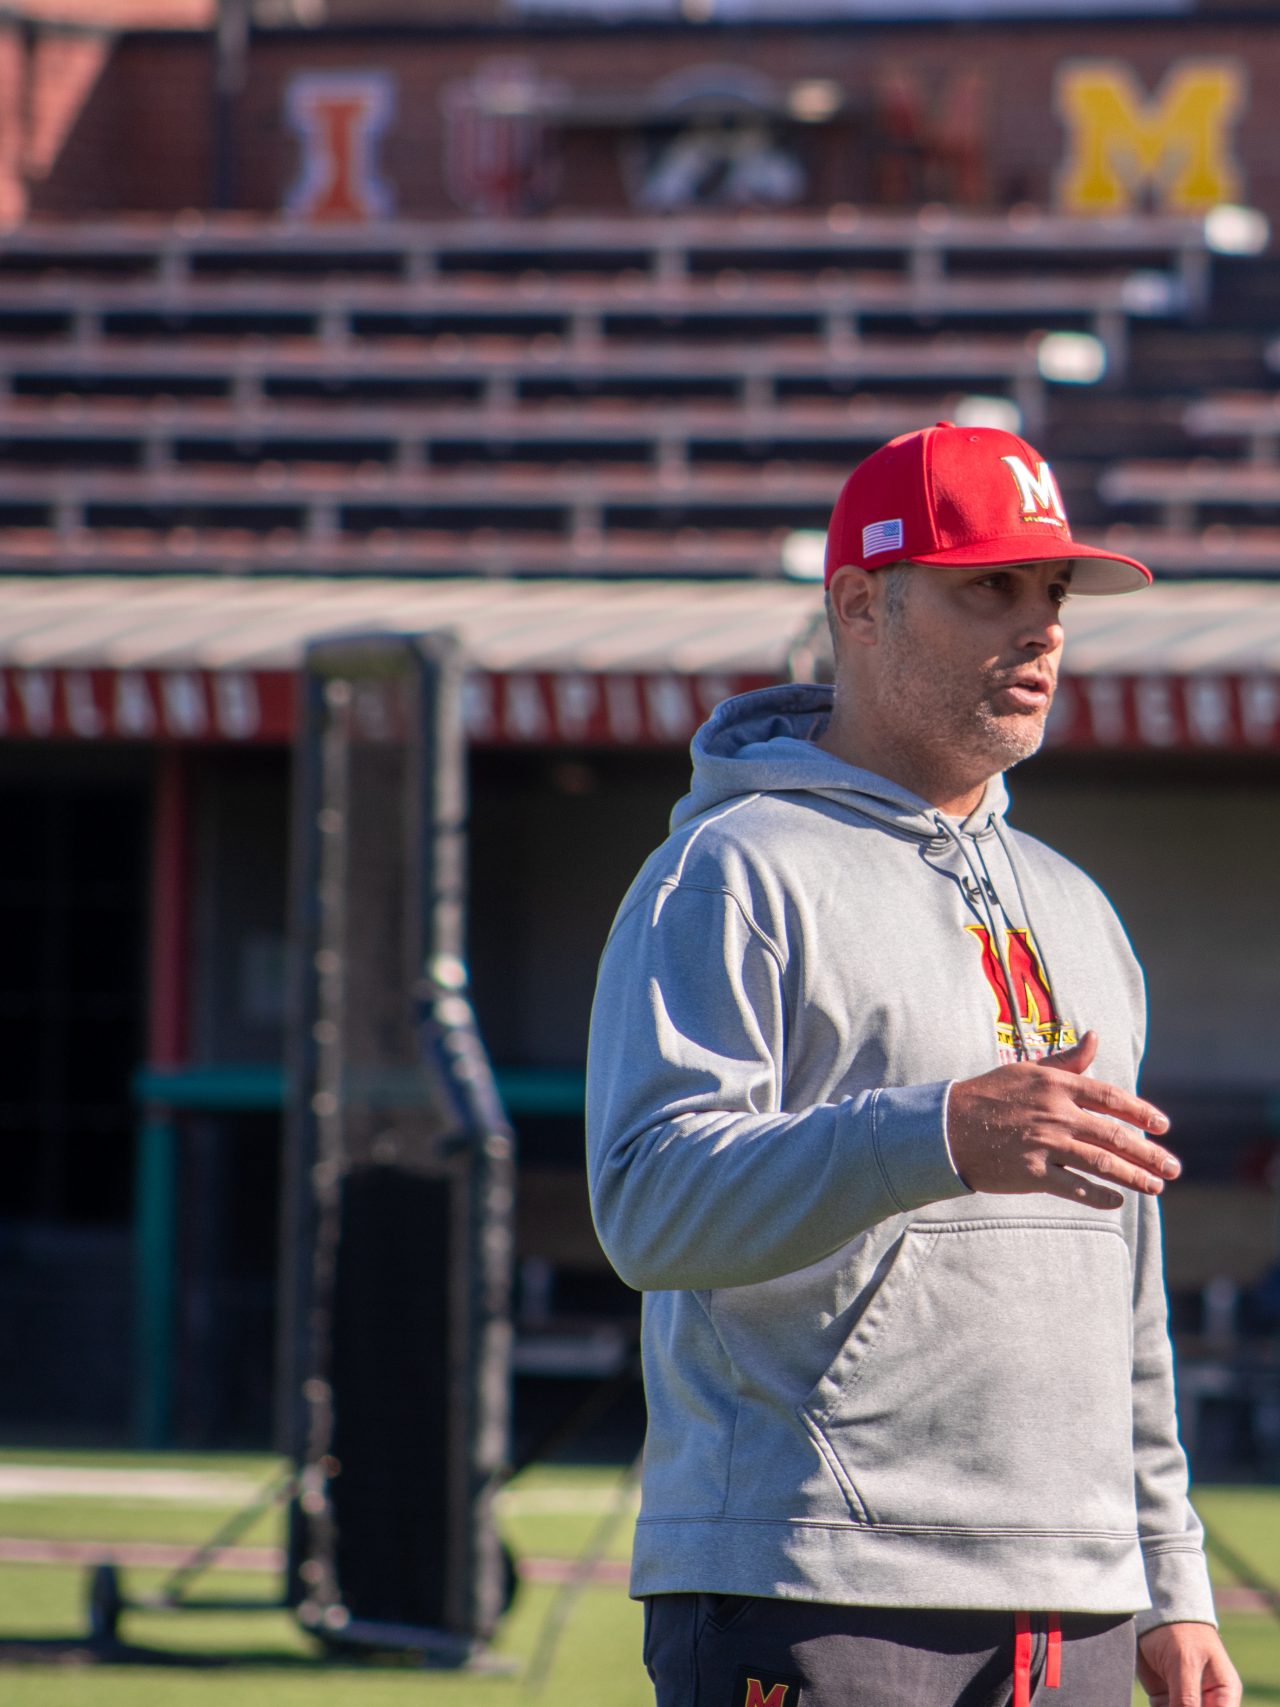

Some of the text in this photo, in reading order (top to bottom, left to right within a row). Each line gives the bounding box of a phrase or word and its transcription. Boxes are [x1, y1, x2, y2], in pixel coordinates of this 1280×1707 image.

[1056, 58, 1248, 216] M
[997, 454, 1067, 522] M
[0, 671, 260, 740] YLAND
